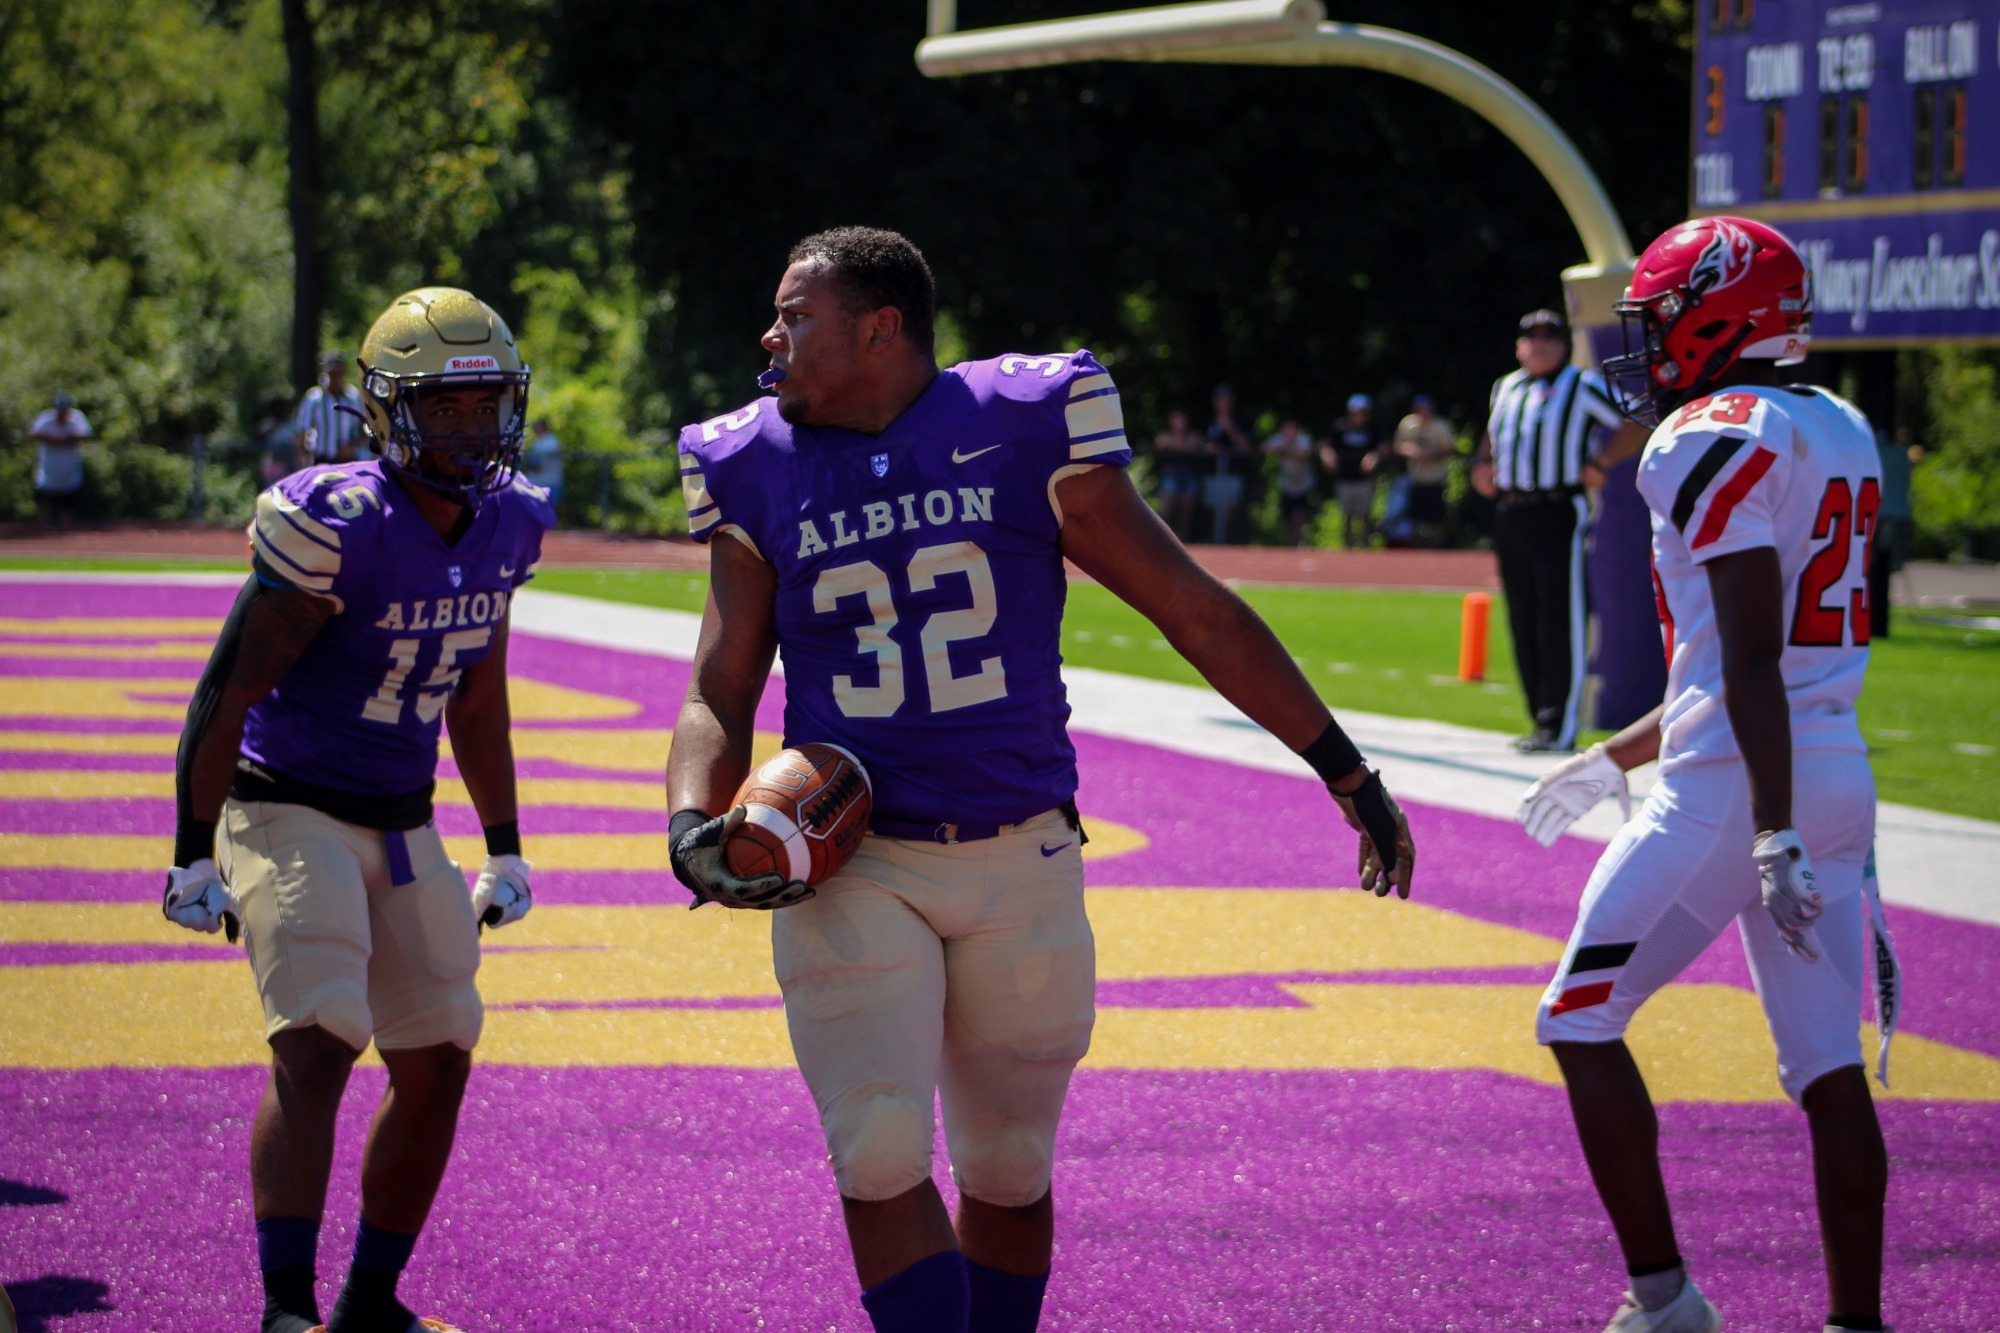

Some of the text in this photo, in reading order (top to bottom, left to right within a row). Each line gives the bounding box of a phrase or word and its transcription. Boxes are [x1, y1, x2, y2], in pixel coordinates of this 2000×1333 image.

[452, 358, 494, 369] Riddell
[1671, 392, 1759, 433] 23
[797, 487, 995, 558] ALBION
[1788, 476, 1881, 647] 23
[375, 591, 507, 631] ALBION
[812, 540, 1008, 718] 32
[361, 626, 491, 724] 15
